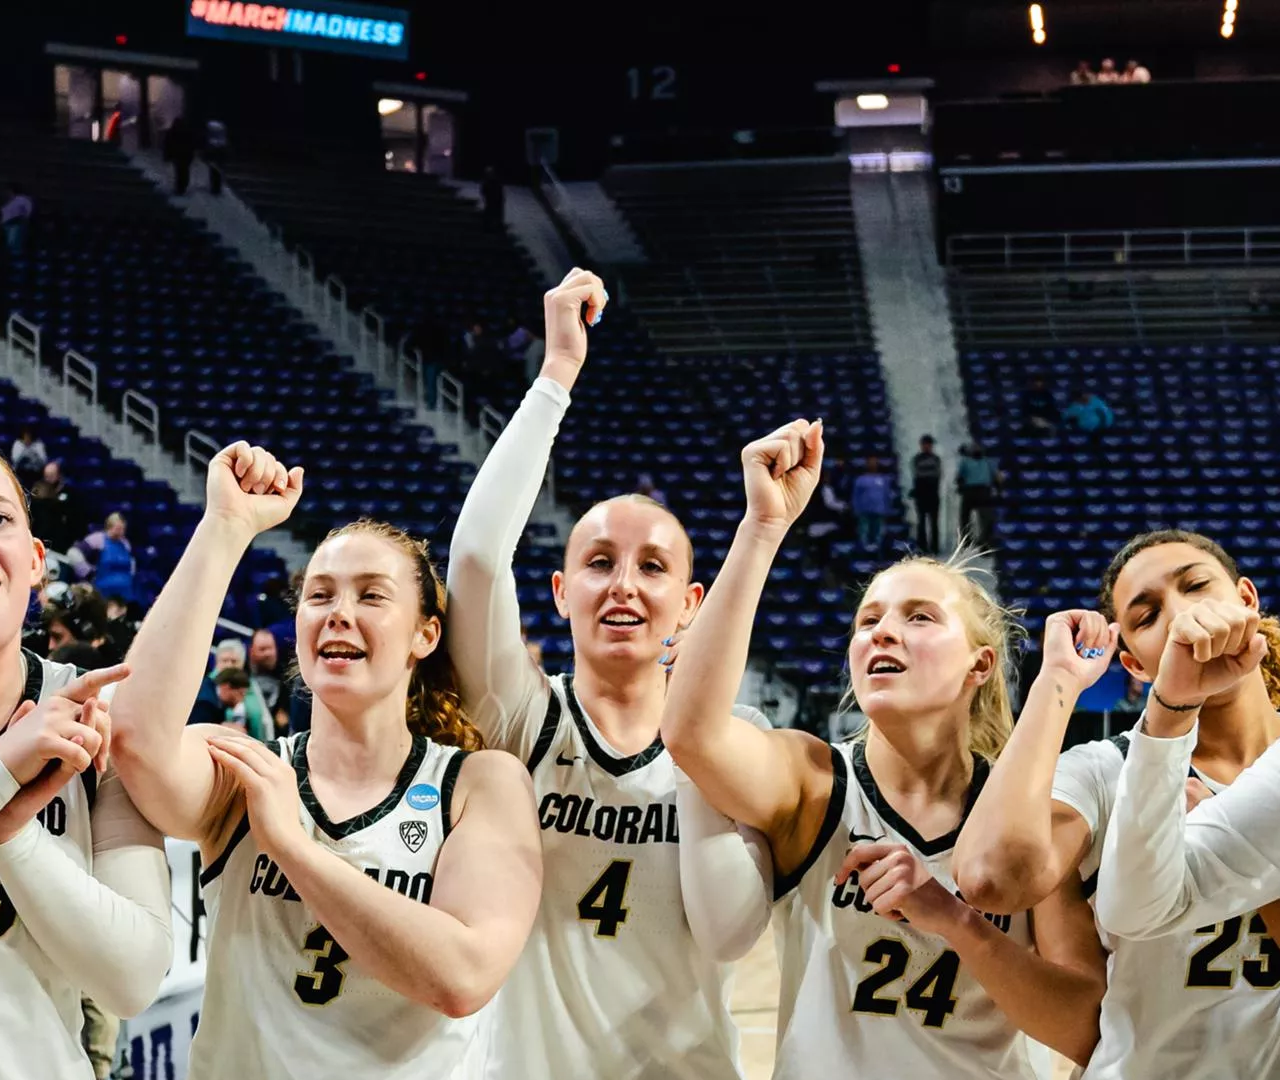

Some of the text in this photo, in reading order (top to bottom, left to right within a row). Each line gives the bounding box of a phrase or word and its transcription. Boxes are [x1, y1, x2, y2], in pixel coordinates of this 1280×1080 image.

[627, 66, 677, 100] 12
[407, 833, 420, 845] 12
[577, 858, 634, 939] 4
[294, 925, 347, 1006] 3
[851, 936, 960, 1028] 24
